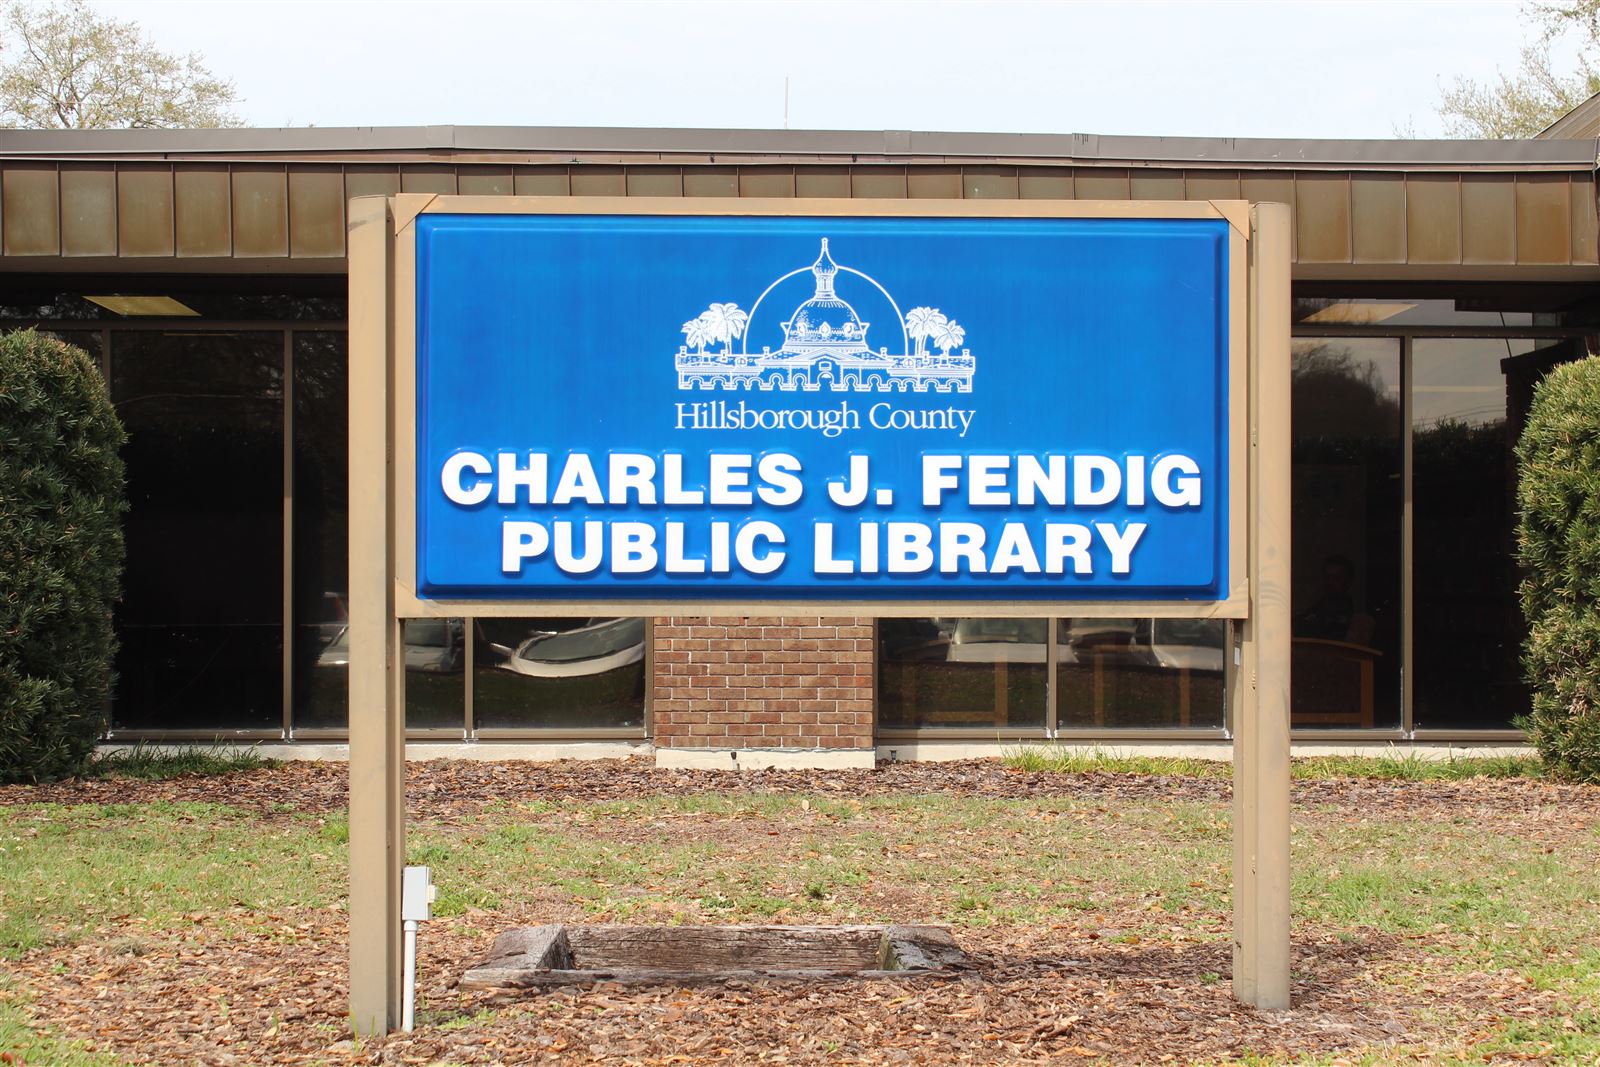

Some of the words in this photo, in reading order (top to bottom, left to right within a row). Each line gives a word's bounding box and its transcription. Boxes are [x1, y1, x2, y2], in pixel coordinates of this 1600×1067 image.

[675, 400, 861, 438] Hillsborough
[869, 402, 976, 438] County
[441, 451, 803, 506] CHARLES
[828, 454, 893, 507] J.
[923, 454, 1201, 507] FENDIG
[501, 520, 786, 574] PUBLIC
[813, 521, 1147, 574] LIBRARY
